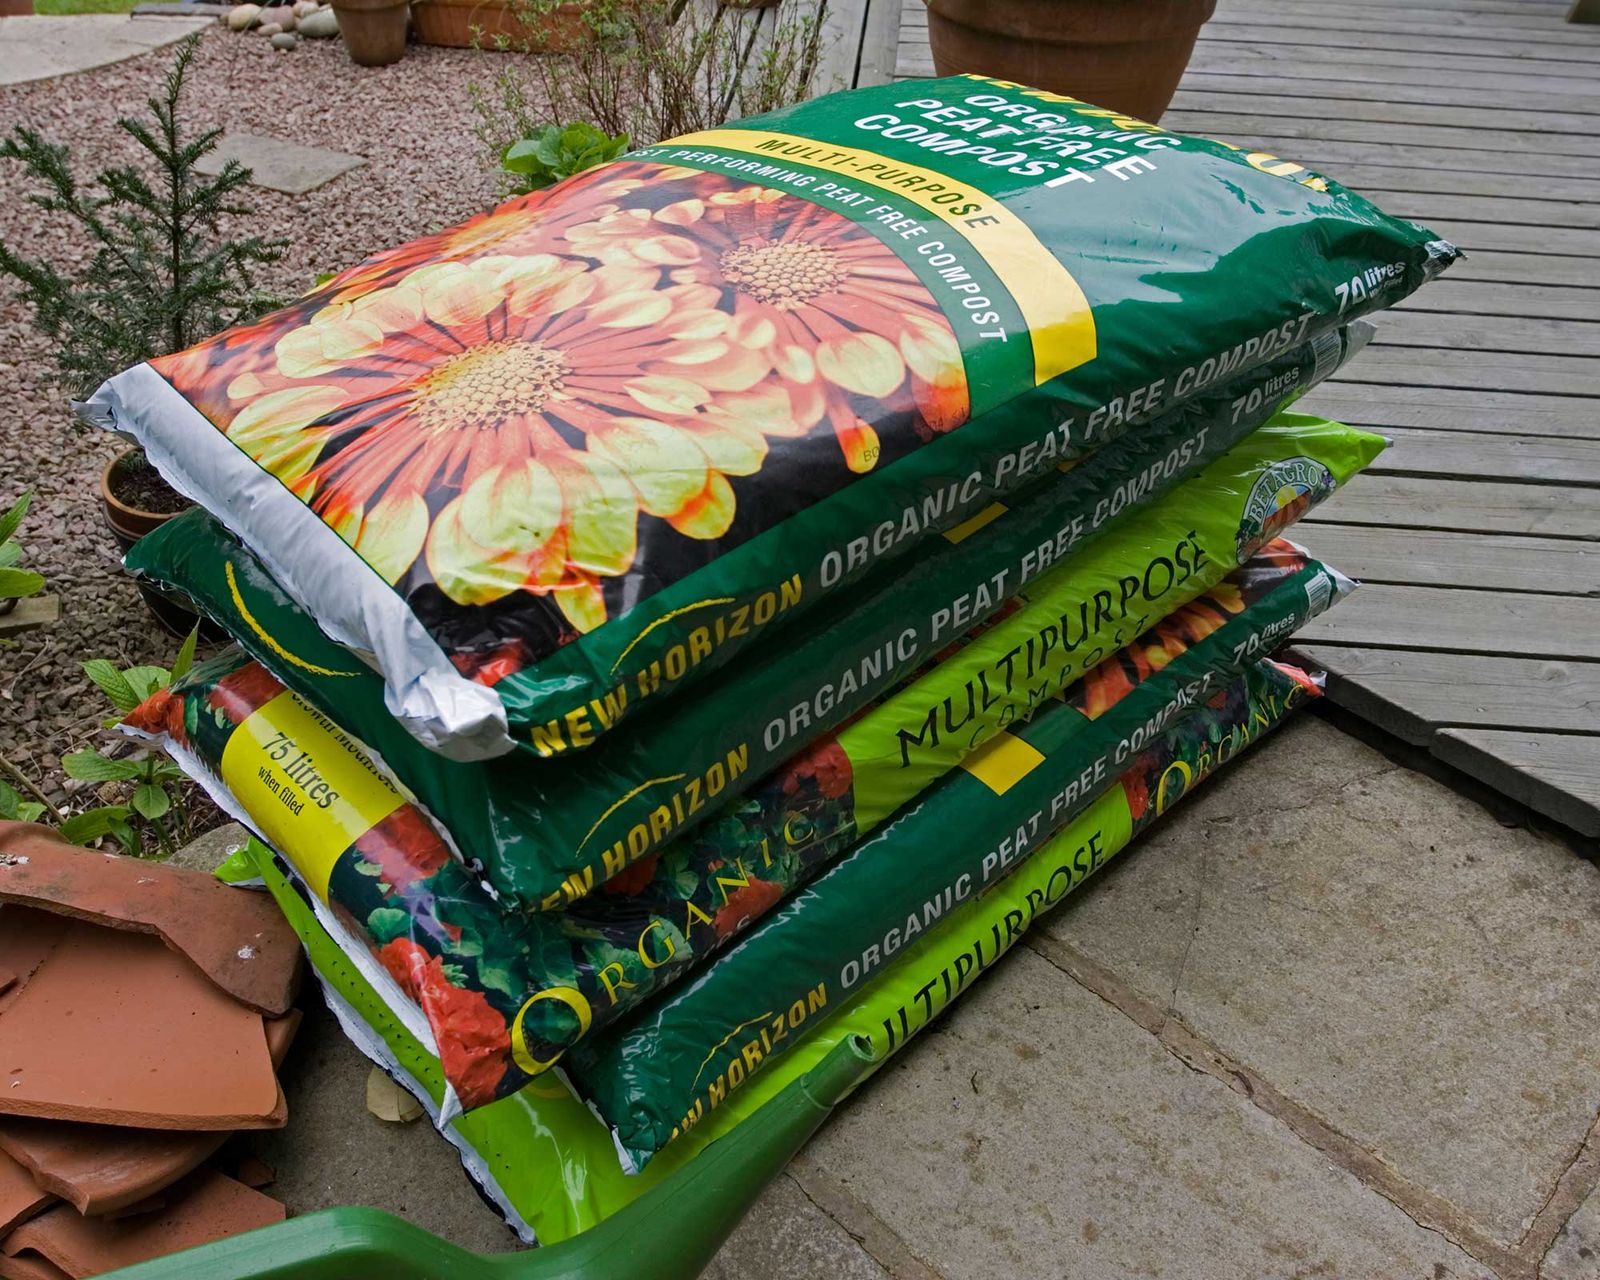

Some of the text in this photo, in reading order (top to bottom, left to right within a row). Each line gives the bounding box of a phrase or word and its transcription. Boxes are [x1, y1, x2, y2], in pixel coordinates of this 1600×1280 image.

[755, 139, 1000, 229] MULTI-PURPOSE
[854, 114, 1096, 188] COMPOST
[896, 98, 1024, 138] PEAT
[1013, 136, 1158, 181] FREE
[669, 150, 816, 187] PERFORMING
[813, 182, 874, 216] PEAT
[865, 206, 927, 240] FREE
[917, 241, 1007, 342] COMPOST
[1334, 276, 1367, 316] 70
[1364, 261, 1406, 289] litres
[1231, 388, 1263, 425] 70
[1264, 366, 1299, 396] litres
[530, 311, 1317, 757] NEW HORIZON ORGANIC PEAT FREE COMPOST
[1249, 462, 1319, 525] BETAGRO
[601, 743, 750, 881] HORIZON
[763, 628, 918, 753] ORGANIC
[930, 568, 1010, 643] PEAT
[1019, 515, 1085, 587] FREE
[1092, 426, 1210, 527] COMPOST
[896, 530, 1210, 768] MULTIPURPOSE
[969, 614, 1149, 750] COMPOST
[1233, 633, 1260, 666] 70
[1262, 613, 1296, 638] litres
[258, 765, 305, 817] when filled
[262, 731, 293, 762] 75
[283, 752, 341, 809] litres
[1156, 684, 1304, 817] ORGANIC
[511, 809, 816, 1076] ORGANIC
[707, 982, 828, 1110] HORIZON
[840, 873, 972, 990] ORGANIC
[982, 810, 1043, 880] PEAT
[1050, 757, 1109, 822] FREE
